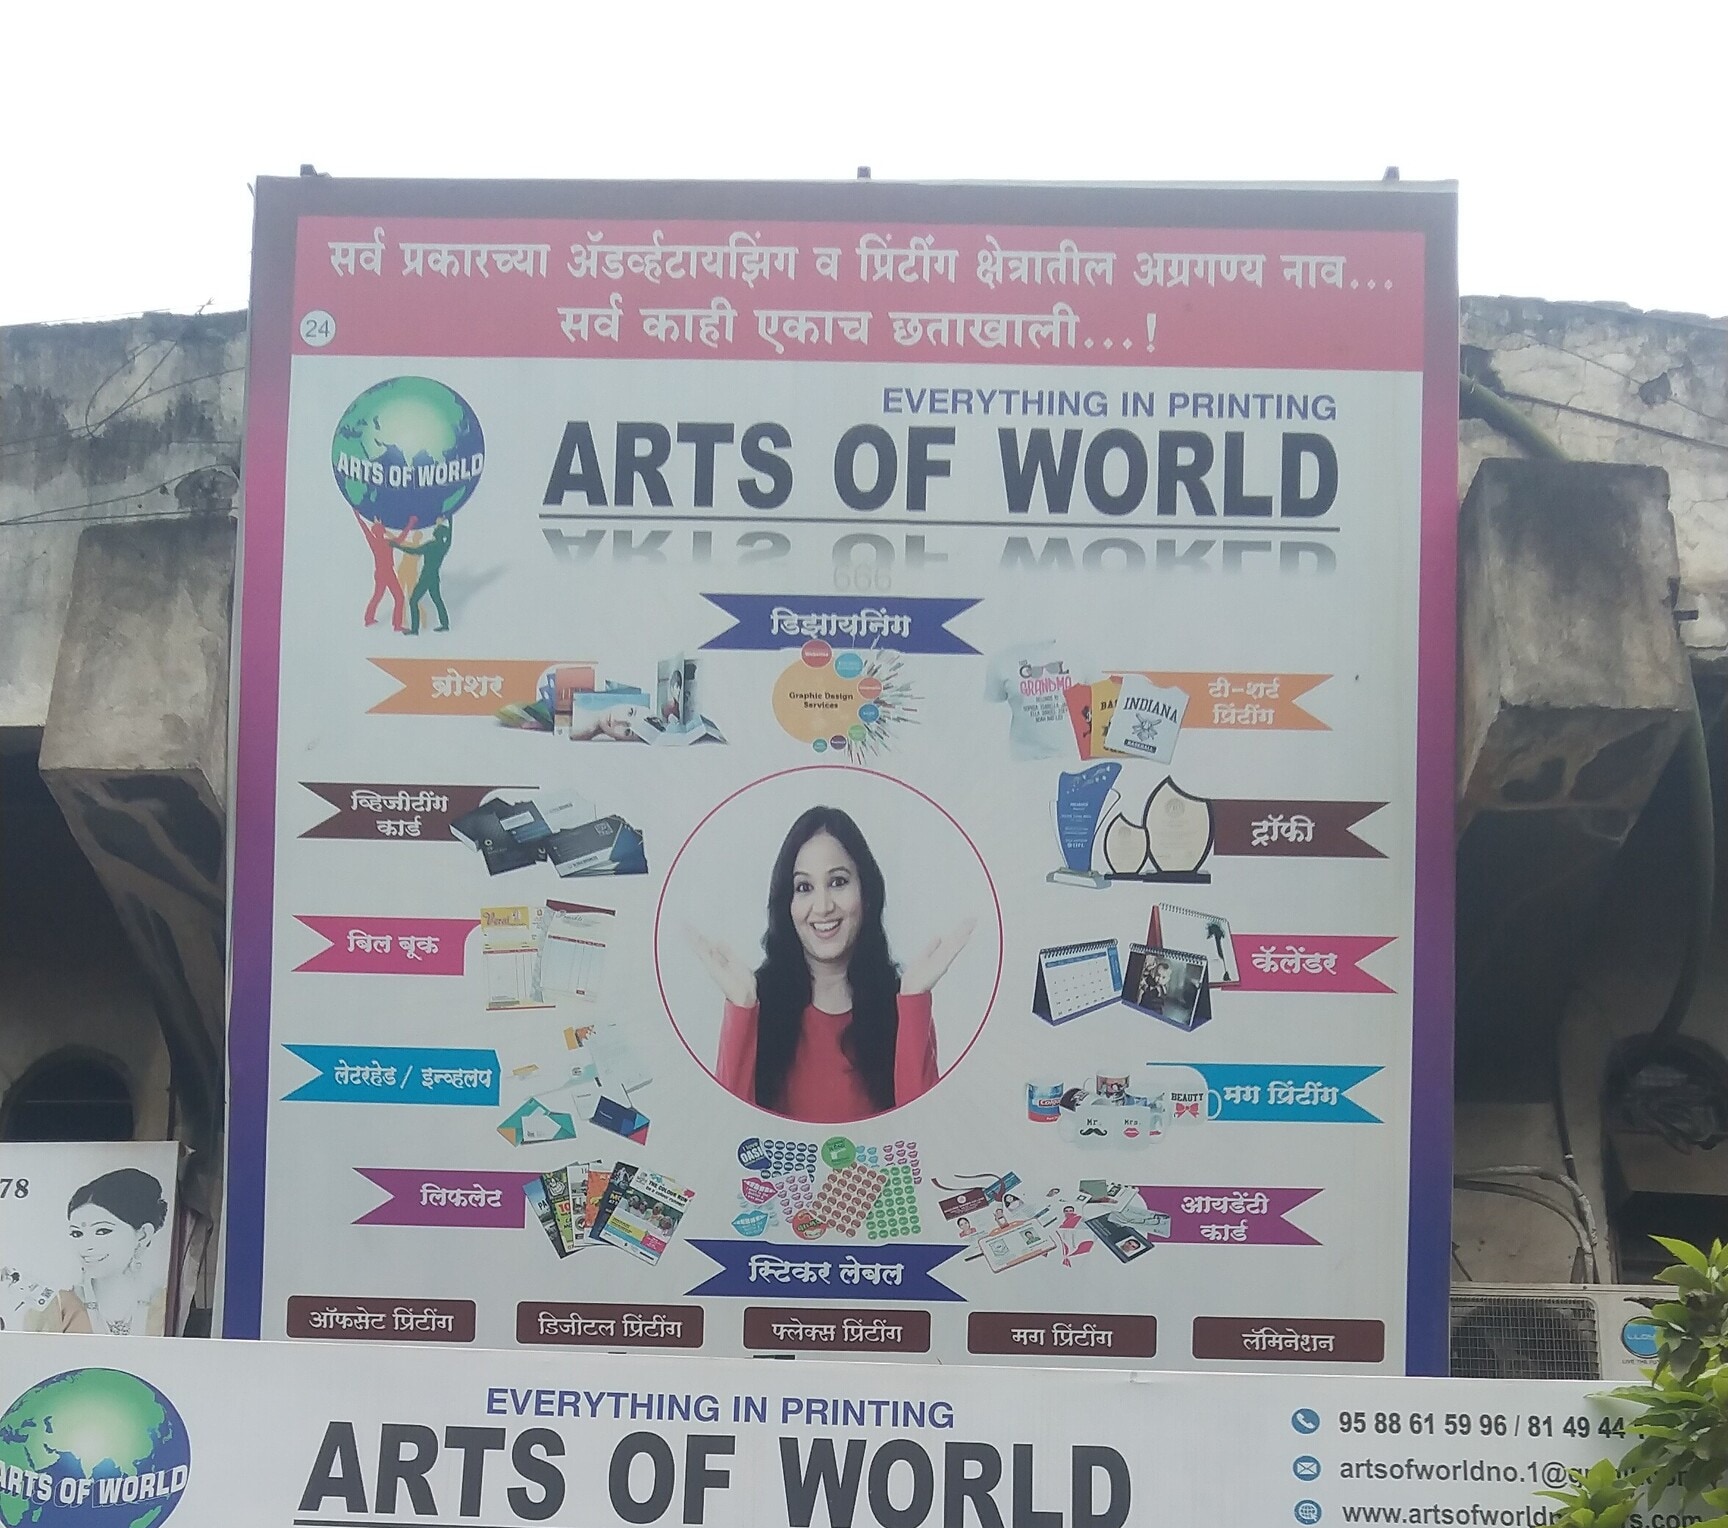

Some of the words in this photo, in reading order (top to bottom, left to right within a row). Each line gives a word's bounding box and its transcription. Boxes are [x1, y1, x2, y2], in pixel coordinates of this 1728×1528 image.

[328, 227, 386, 277] सर्व
[400, 242, 550, 280] प्रकारच्या
[814, 247, 841, 279] व
[857, 233, 959, 283] प्रिंटींग
[976, 235, 1117, 289] क्षेत्रातील
[1134, 253, 1267, 289] अग्रगण्य
[304, 318, 331, 339] 24
[557, 293, 623, 343] सर्व
[639, 296, 737, 347] काही
[753, 309, 873, 353] एकाच
[882, 386, 1109, 417] EVERYTHING
[1121, 391, 1156, 418] IN
[1168, 392, 1338, 421] PRINTING
[336, 451, 385, 486] ARTS
[388, 465, 416, 488] OF
[416, 452, 485, 487] WORLD
[542, 420, 794, 510] ARTS
[834, 423, 957, 512] OF
[998, 427, 1339, 519] WORLD
[771, 607, 912, 639] डिझायनिंग
[431, 668, 504, 699] ब्रोशर
[789, 692, 823, 703] Graphic
[824, 692, 854, 702] Design
[1208, 677, 1280, 700] टी-शर्ट
[803, 701, 839, 710] Services
[1123, 697, 1178, 724] INDIANA
[1212, 704, 1276, 726] प्रिंटींग
[350, 790, 450, 813] व्हिजीटींग
[376, 814, 421, 838] कार्ड
[1250, 814, 1316, 847] ट्रॉफी
[347, 929, 391, 953] बिल
[398, 935, 440, 960] बूक
[1251, 944, 1338, 975] कॅलेंडर
[333, 1059, 398, 1088] लेटरहेड
[421, 1065, 492, 1089] इन्व्हलप
[1171, 1092, 1204, 1102] BEAUTY
[1222, 1084, 1263, 1102] मग
[1267, 1079, 1339, 1106] प्रिंटींग
[420, 1182, 502, 1208] लिफलेट
[1181, 1190, 1270, 1217] आयडेंटी
[1199, 1220, 1248, 1243] कार्ड
[748, 1253, 833, 1285] स्टिकर
[839, 1255, 905, 1286] लेबल
[308, 1305, 387, 1331] ऑफसेट
[392, 1306, 455, 1332] प्रिंटींग
[537, 1311, 616, 1338] डिजीटल
[621, 1313, 683, 1339] प्रिंटींग
[771, 1316, 837, 1342] फ्लेक्स
[842, 1317, 904, 1343] प्रिंटींग
[1010, 1325, 1046, 1348] मग
[1051, 1322, 1113, 1349] प्रिंटींग
[1241, 1325, 1335, 1354] लॅमिनेशन
[486, 1386, 720, 1423] EVERYTHING
[732, 1396, 768, 1424] IN
[781, 1397, 955, 1429] PRINTING
[1338, 1411, 1367, 1434] 95
[1373, 1411, 1401, 1435] 88
[1409, 1412, 1435, 1435] 61
[1444, 1413, 1472, 1436] 59
[1479, 1413, 1507, 1437] 96
[1513, 1414, 1522, 1438] /
[1527, 1415, 1554, 1438] 81
[1562, 1415, 1591, 1439] 49
[1597, 1416, 1627, 1440] 44
[59, 1477, 93, 1506] OF
[99, 1464, 189, 1505] WORLD
[298, 1421, 566, 1521] ARTS
[608, 1431, 736, 1525] OF
